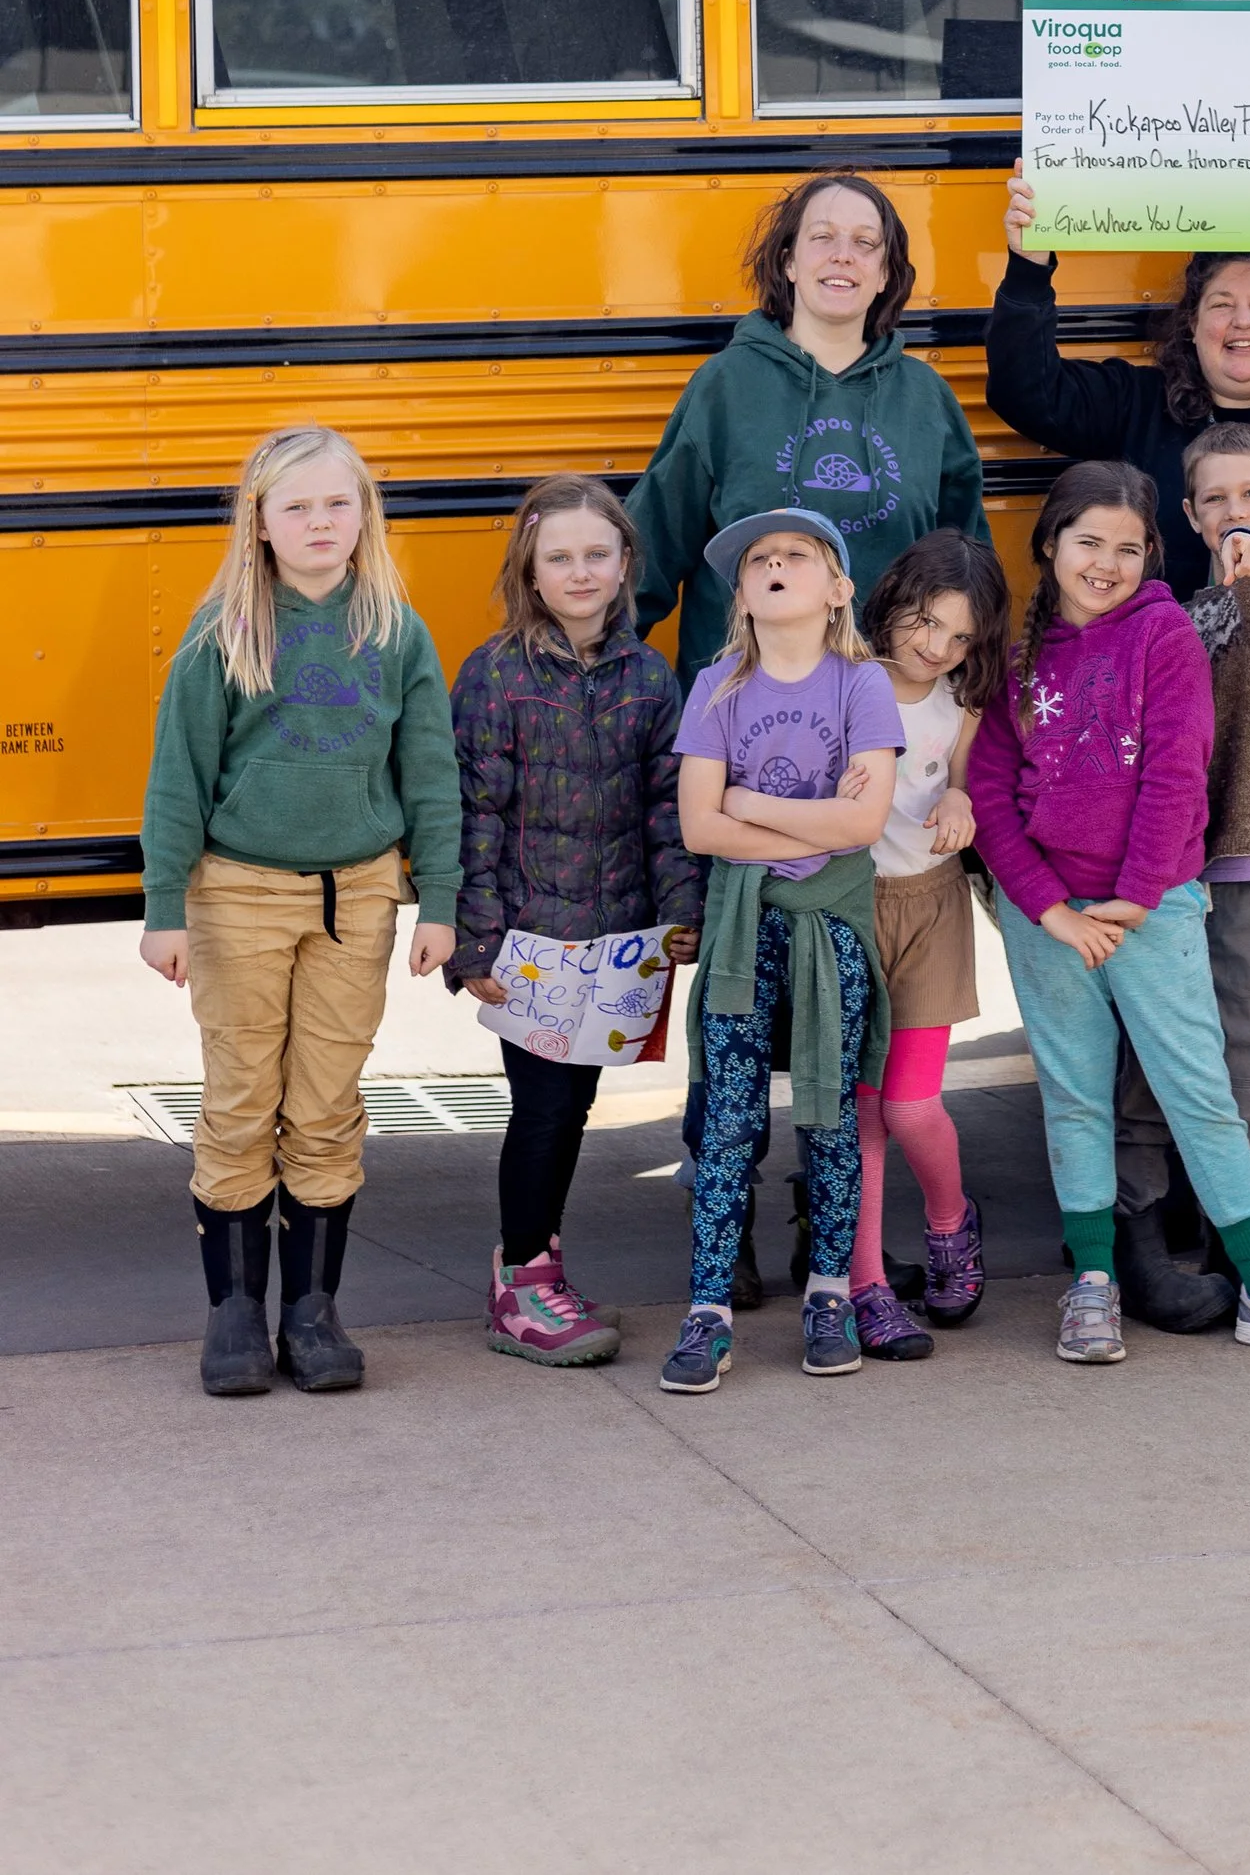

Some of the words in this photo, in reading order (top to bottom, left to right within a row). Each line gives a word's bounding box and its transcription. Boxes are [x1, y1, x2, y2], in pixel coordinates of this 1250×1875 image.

[1032, 18, 1122, 41] Viroqua
[1048, 42, 1081, 54] food
[1035, 112, 1052, 122] Pay
[1055, 113, 1066, 121] to
[1068, 112, 1084, 121] the
[1089, 98, 1182, 147] Kickapoo
[1183, 99, 1236, 142] Valley
[1041, 125, 1072, 134] Order
[1075, 125, 1086, 134] of
[1030, 143, 1067, 169] Four
[1150, 148, 1182, 168] One
[1035, 224, 1051, 233] For
[1055, 205, 1091, 235] Give
[1093, 207, 1142, 233] Where
[1147, 205, 1170, 231] You
[1176, 205, 1216, 232] Live
[6, 722, 53, 737] BETWEEN
[0, 739, 29, 755] RAME
[35, 737, 64, 752] RAILS
[733, 710, 803, 780] Kickapoo
[810, 711, 843, 781] Valley
